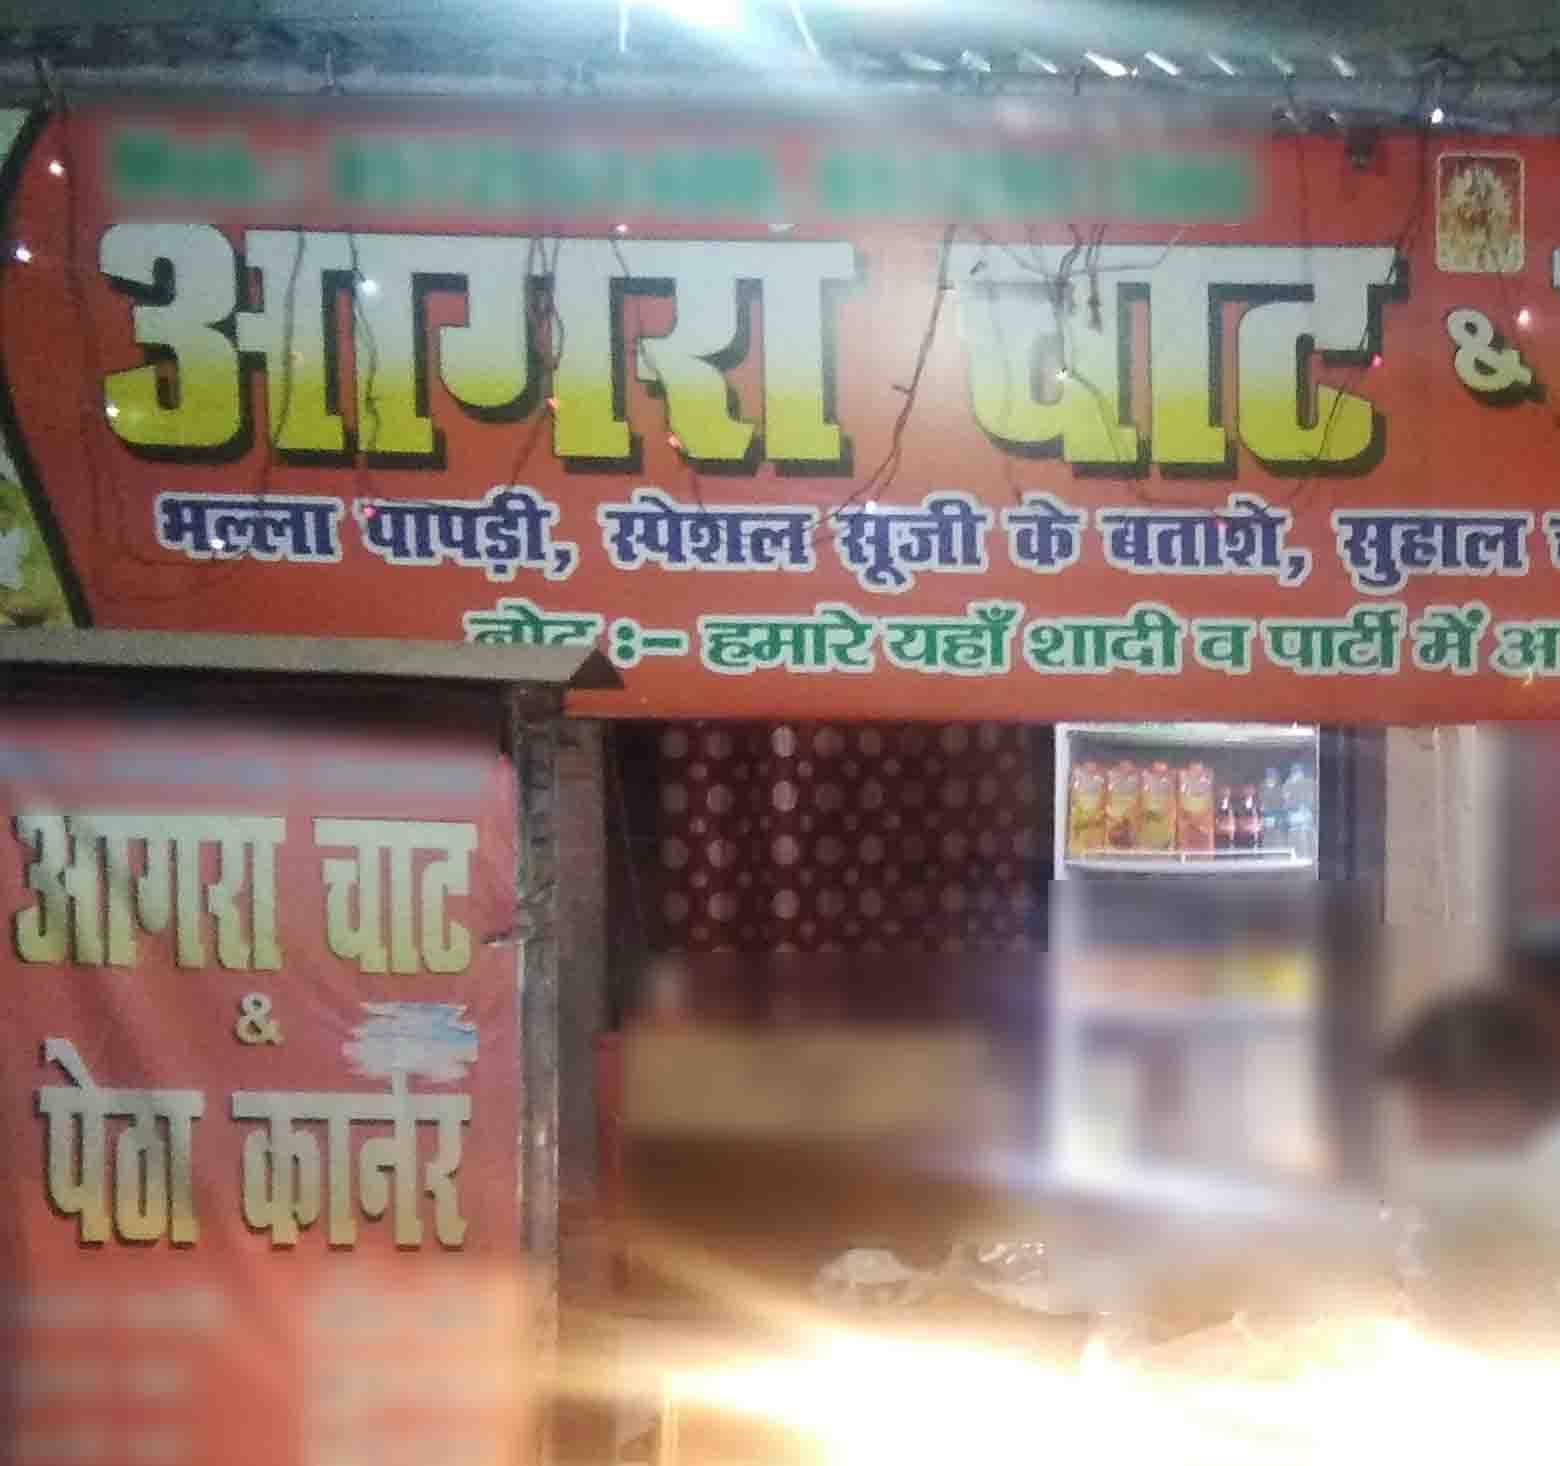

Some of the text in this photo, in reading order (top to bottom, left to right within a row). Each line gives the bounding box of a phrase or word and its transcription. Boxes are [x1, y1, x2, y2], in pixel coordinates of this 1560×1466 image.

[100, 224, 856, 474] आगरा
[940, 244, 1400, 476] चाट
[1447, 309, 1540, 398] &
[158, 498, 339, 556] भल्ला
[364, 488, 576, 574] पापड़ी,
[605, 498, 812, 564] स्पेशल
[840, 500, 985, 584] सूजी
[1009, 501, 1079, 568] के
[1339, 516, 1527, 584] सुहाल
[705, 612, 872, 666] हमारे
[886, 608, 1012, 667] यहाँ
[1030, 610, 1183, 668] शादी
[1198, 620, 1252, 668] व
[1265, 608, 1402, 670] पार्टी
[1414, 607, 1483, 668] में
[14, 813, 478, 974] आगरा चाट
[234, 993, 284, 1046] &
[39, 1036, 204, 1246] पेठा
